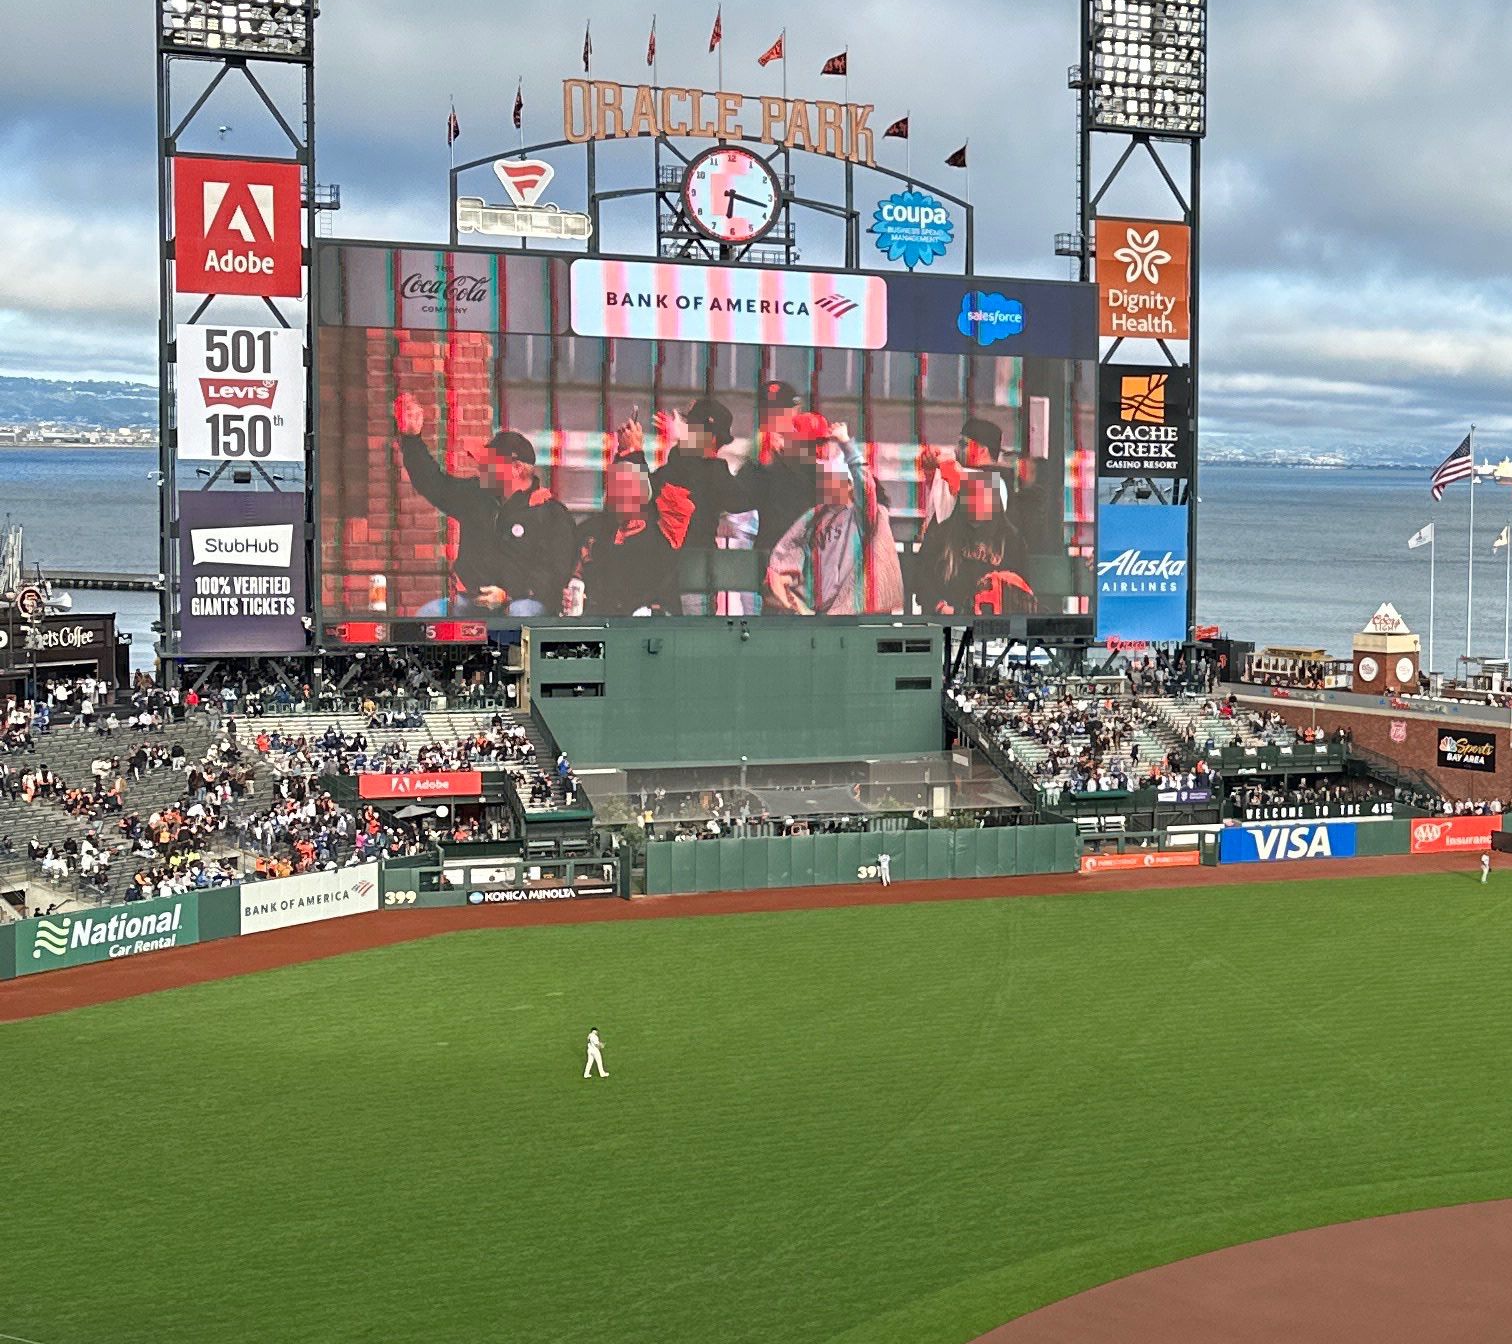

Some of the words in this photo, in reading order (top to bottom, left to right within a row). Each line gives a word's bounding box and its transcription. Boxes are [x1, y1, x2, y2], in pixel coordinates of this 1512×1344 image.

[562, 78, 743, 143] ORACLE
[759, 95, 877, 168] PARK
[710, 157, 718, 166] 11
[696, 171, 706, 179] 10
[882, 204, 947, 228] coupa
[204, 249, 275, 275] Adobe
[606, 291, 668, 309] BANK
[676, 295, 704, 311] OF
[709, 296, 810, 316] AMERICA
[1108, 288, 1176, 316] Dignity
[967, 310, 1023, 325] salesforce
[1111, 312, 1173, 333] Health
[205, 328, 272, 374] 501
[1106, 425, 1178, 441] CACHE
[1108, 442, 1176, 457] CREEK
[1106, 460, 1141, 469] CASINO
[1143, 461, 1178, 469] RESORT
[204, 537, 279, 554] StubHub
[1097, 548, 1186, 579] Alaska
[195, 576, 231, 595] 100%
[233, 576, 291, 595] VERIFIED
[1102, 582, 1177, 592] AIRLINES
[191, 597, 239, 616] GIANTS
[241, 597, 295, 616] TICKETS
[60, 625, 94, 648] Coffee
[1455, 738, 1494, 756] Sports
[1446, 753, 1461, 762] BAY
[1463, 755, 1485, 764] AREA
[414, 780, 449, 790] Adobe
[1246, 806, 1303, 820] WELCOME
[1315, 805, 1329, 819] TO
[1340, 804, 1361, 816] THE
[1371, 802, 1393, 814] 415
[1246, 826, 1332, 860] VISA
[244, 901, 278, 918] BANK
[280, 897, 296, 910] OF
[298, 889, 350, 908] AMERICA
[384, 890, 417, 905] 399
[484, 891, 527, 902] KONICA
[529, 888, 576, 900] MINOLTA
[71, 903, 181, 949] National
[108, 943, 132, 958] Car
[134, 934, 176, 954] Rental
